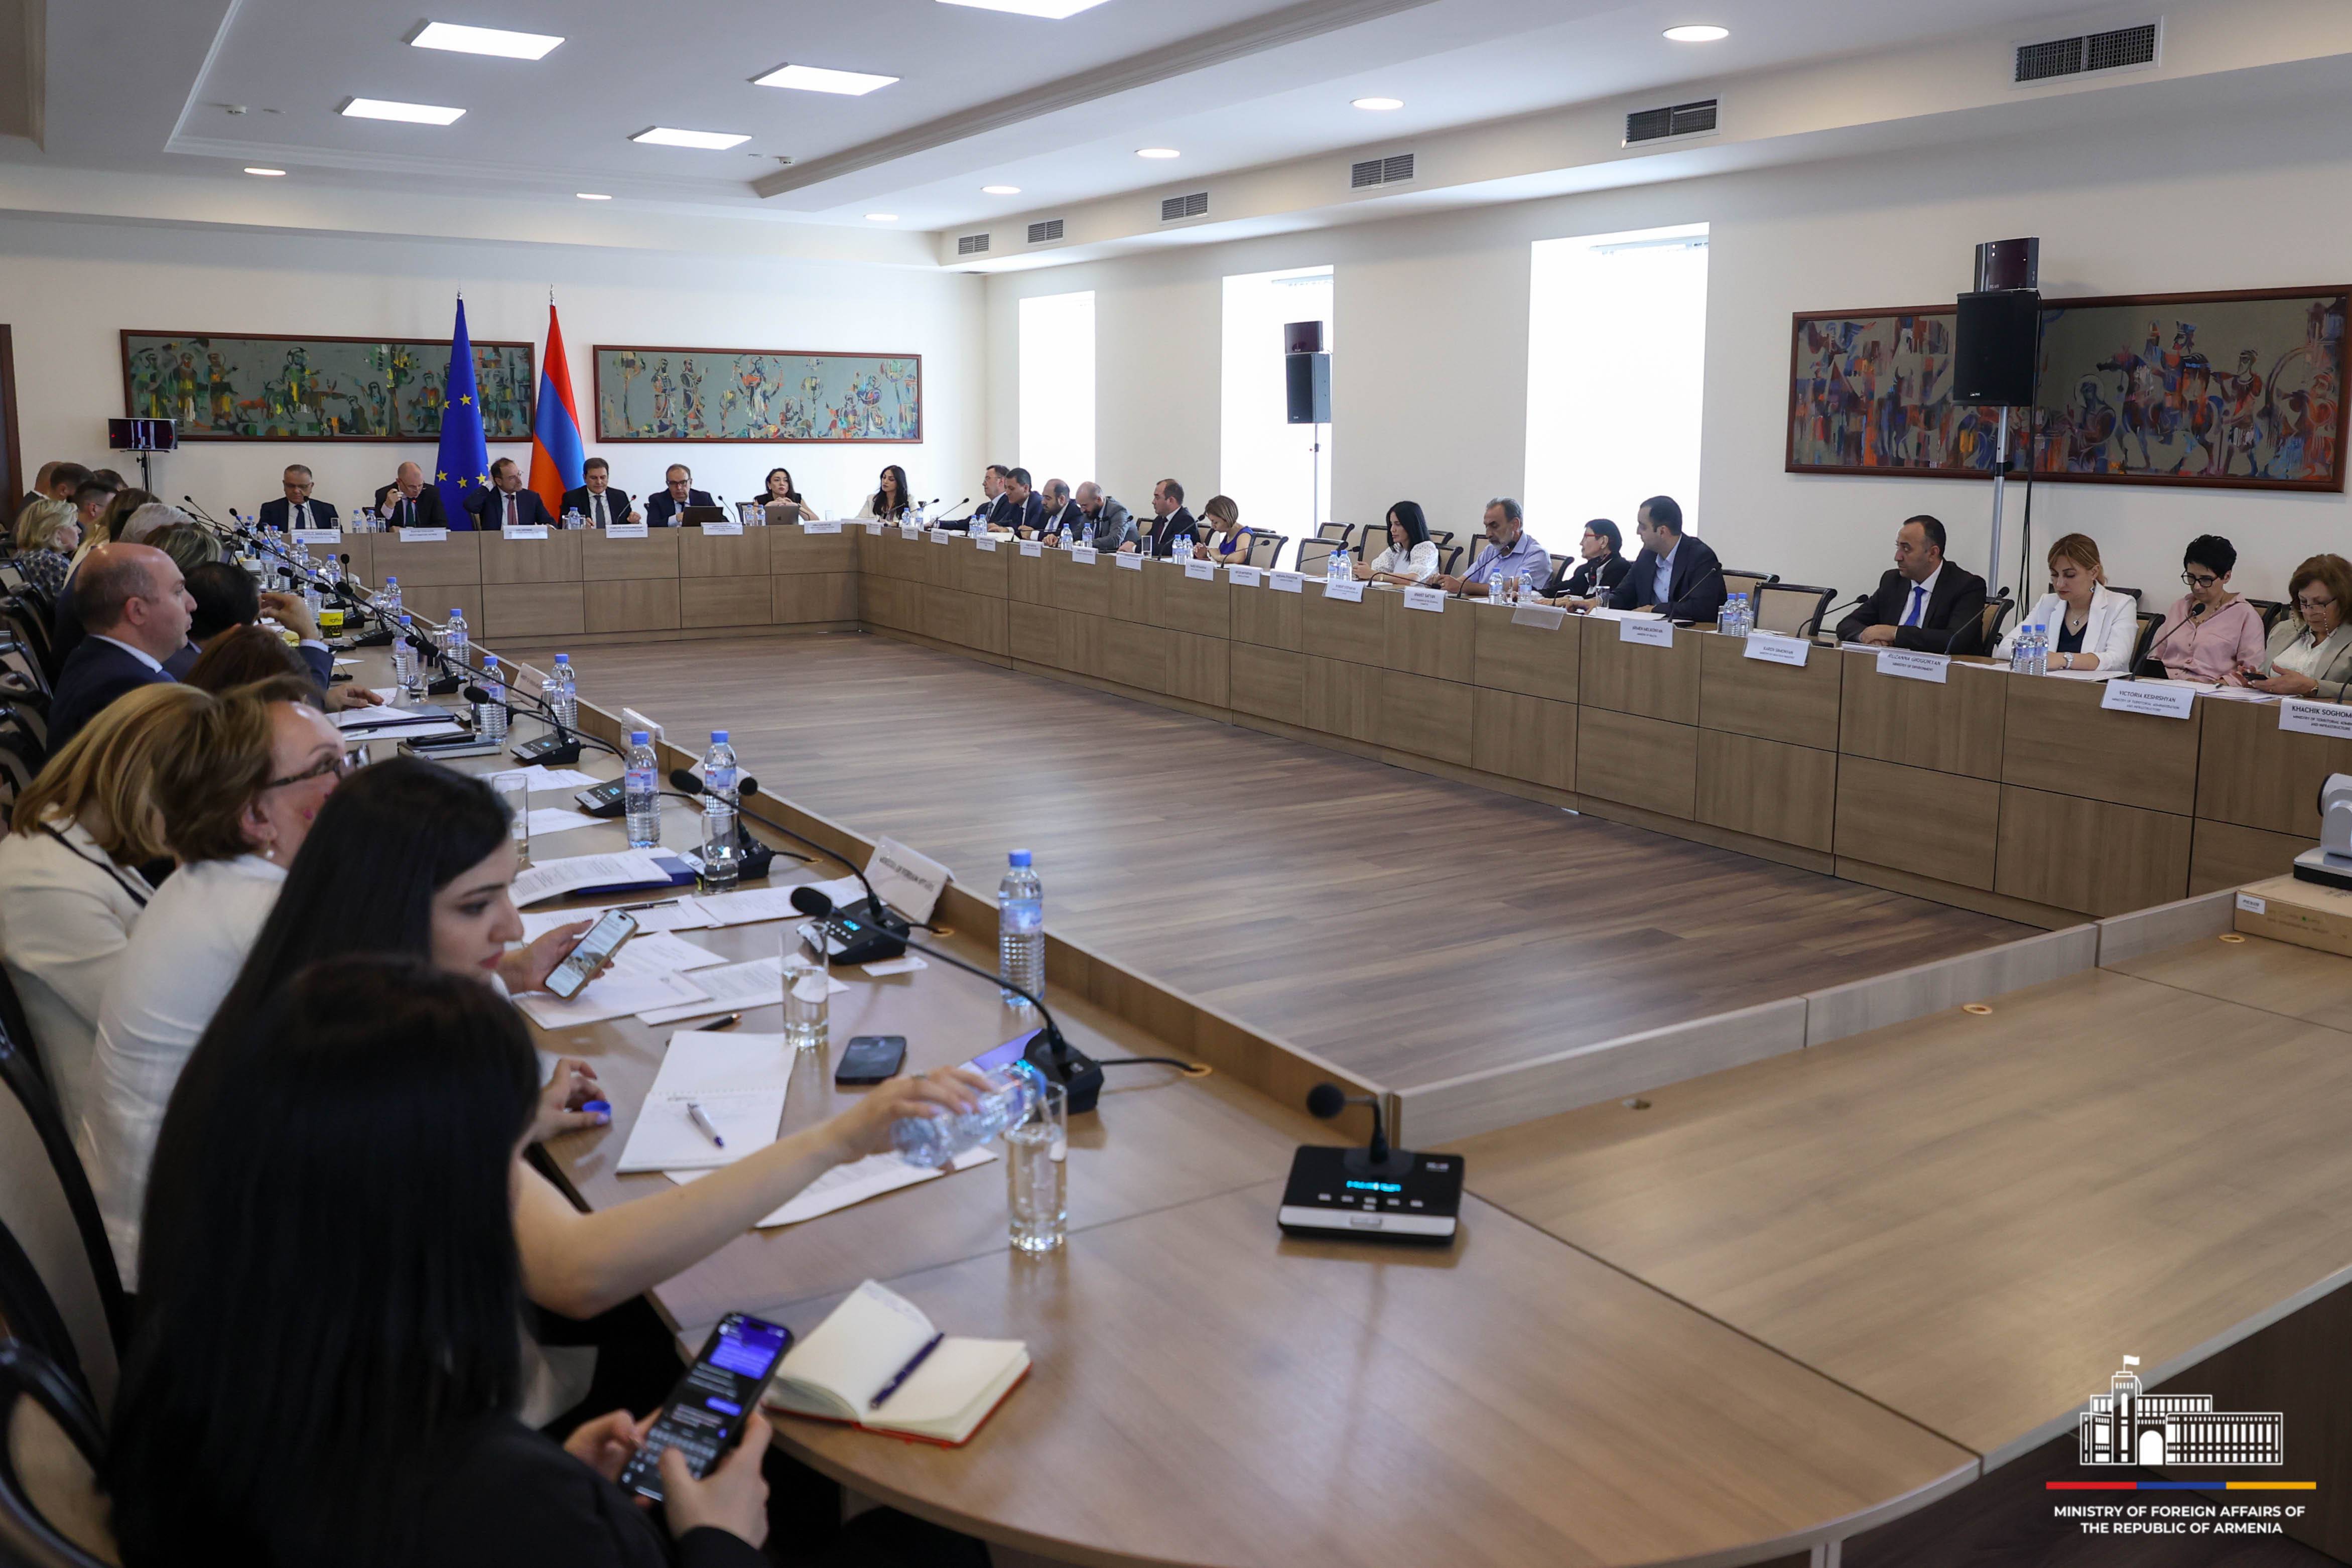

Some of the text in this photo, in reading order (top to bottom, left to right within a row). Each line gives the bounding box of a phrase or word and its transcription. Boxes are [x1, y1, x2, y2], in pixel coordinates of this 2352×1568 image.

[2144, 694, 2176, 702] KESHISHYAN
[2292, 705, 2352, 718] KHACHIK SOGHOM
